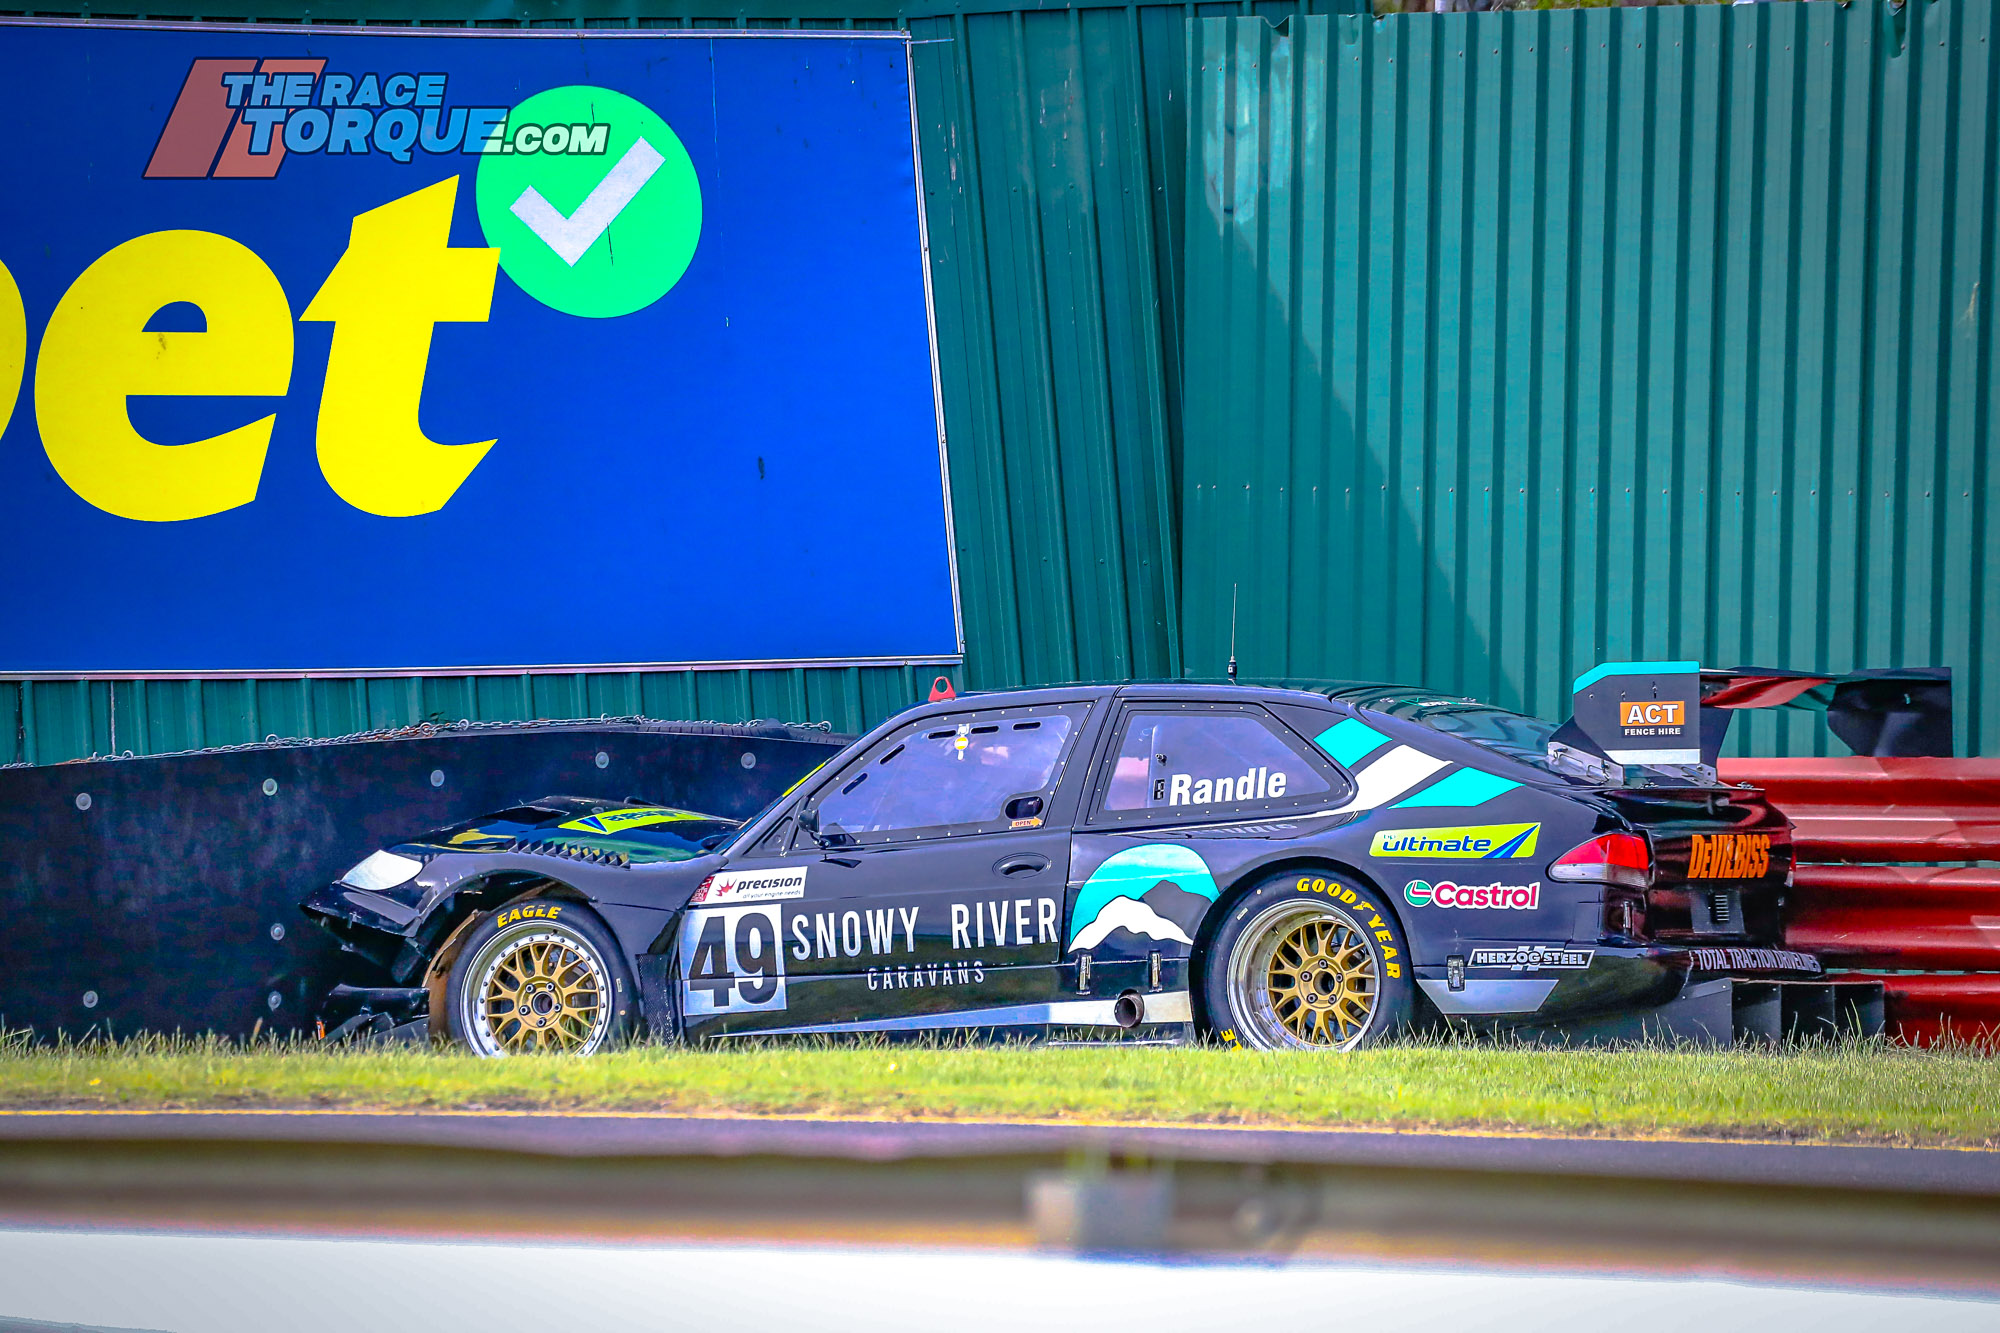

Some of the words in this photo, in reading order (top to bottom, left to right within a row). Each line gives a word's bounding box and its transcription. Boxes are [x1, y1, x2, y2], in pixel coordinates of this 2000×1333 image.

[0, 174, 500, 522] et
[1627, 704, 1678, 724] ACT
[1624, 728, 1656, 736] FENCE
[1658, 727, 1681, 735] HIRE
[1169, 767, 1287, 806] Randle
[1015, 819, 1031, 827] OPEN
[1382, 836, 1491, 852] ultimate
[736, 877, 803, 893] precision
[1435, 884, 1537, 906] Castrol
[497, 904, 562, 928] EAGLE
[791, 906, 919, 961] SNOWY
[950, 897, 1059, 950] RIVER
[1296, 878, 1401, 979] GOODYEAR
[689, 912, 779, 1008] 49
[1476, 951, 1541, 964] HERZOG
[1543, 951, 1586, 965] STEEL
[1695, 949, 1731, 971] TOTAL
[1730, 949, 1778, 969] TRACTION
[867, 960, 984, 991] CARAVANS
